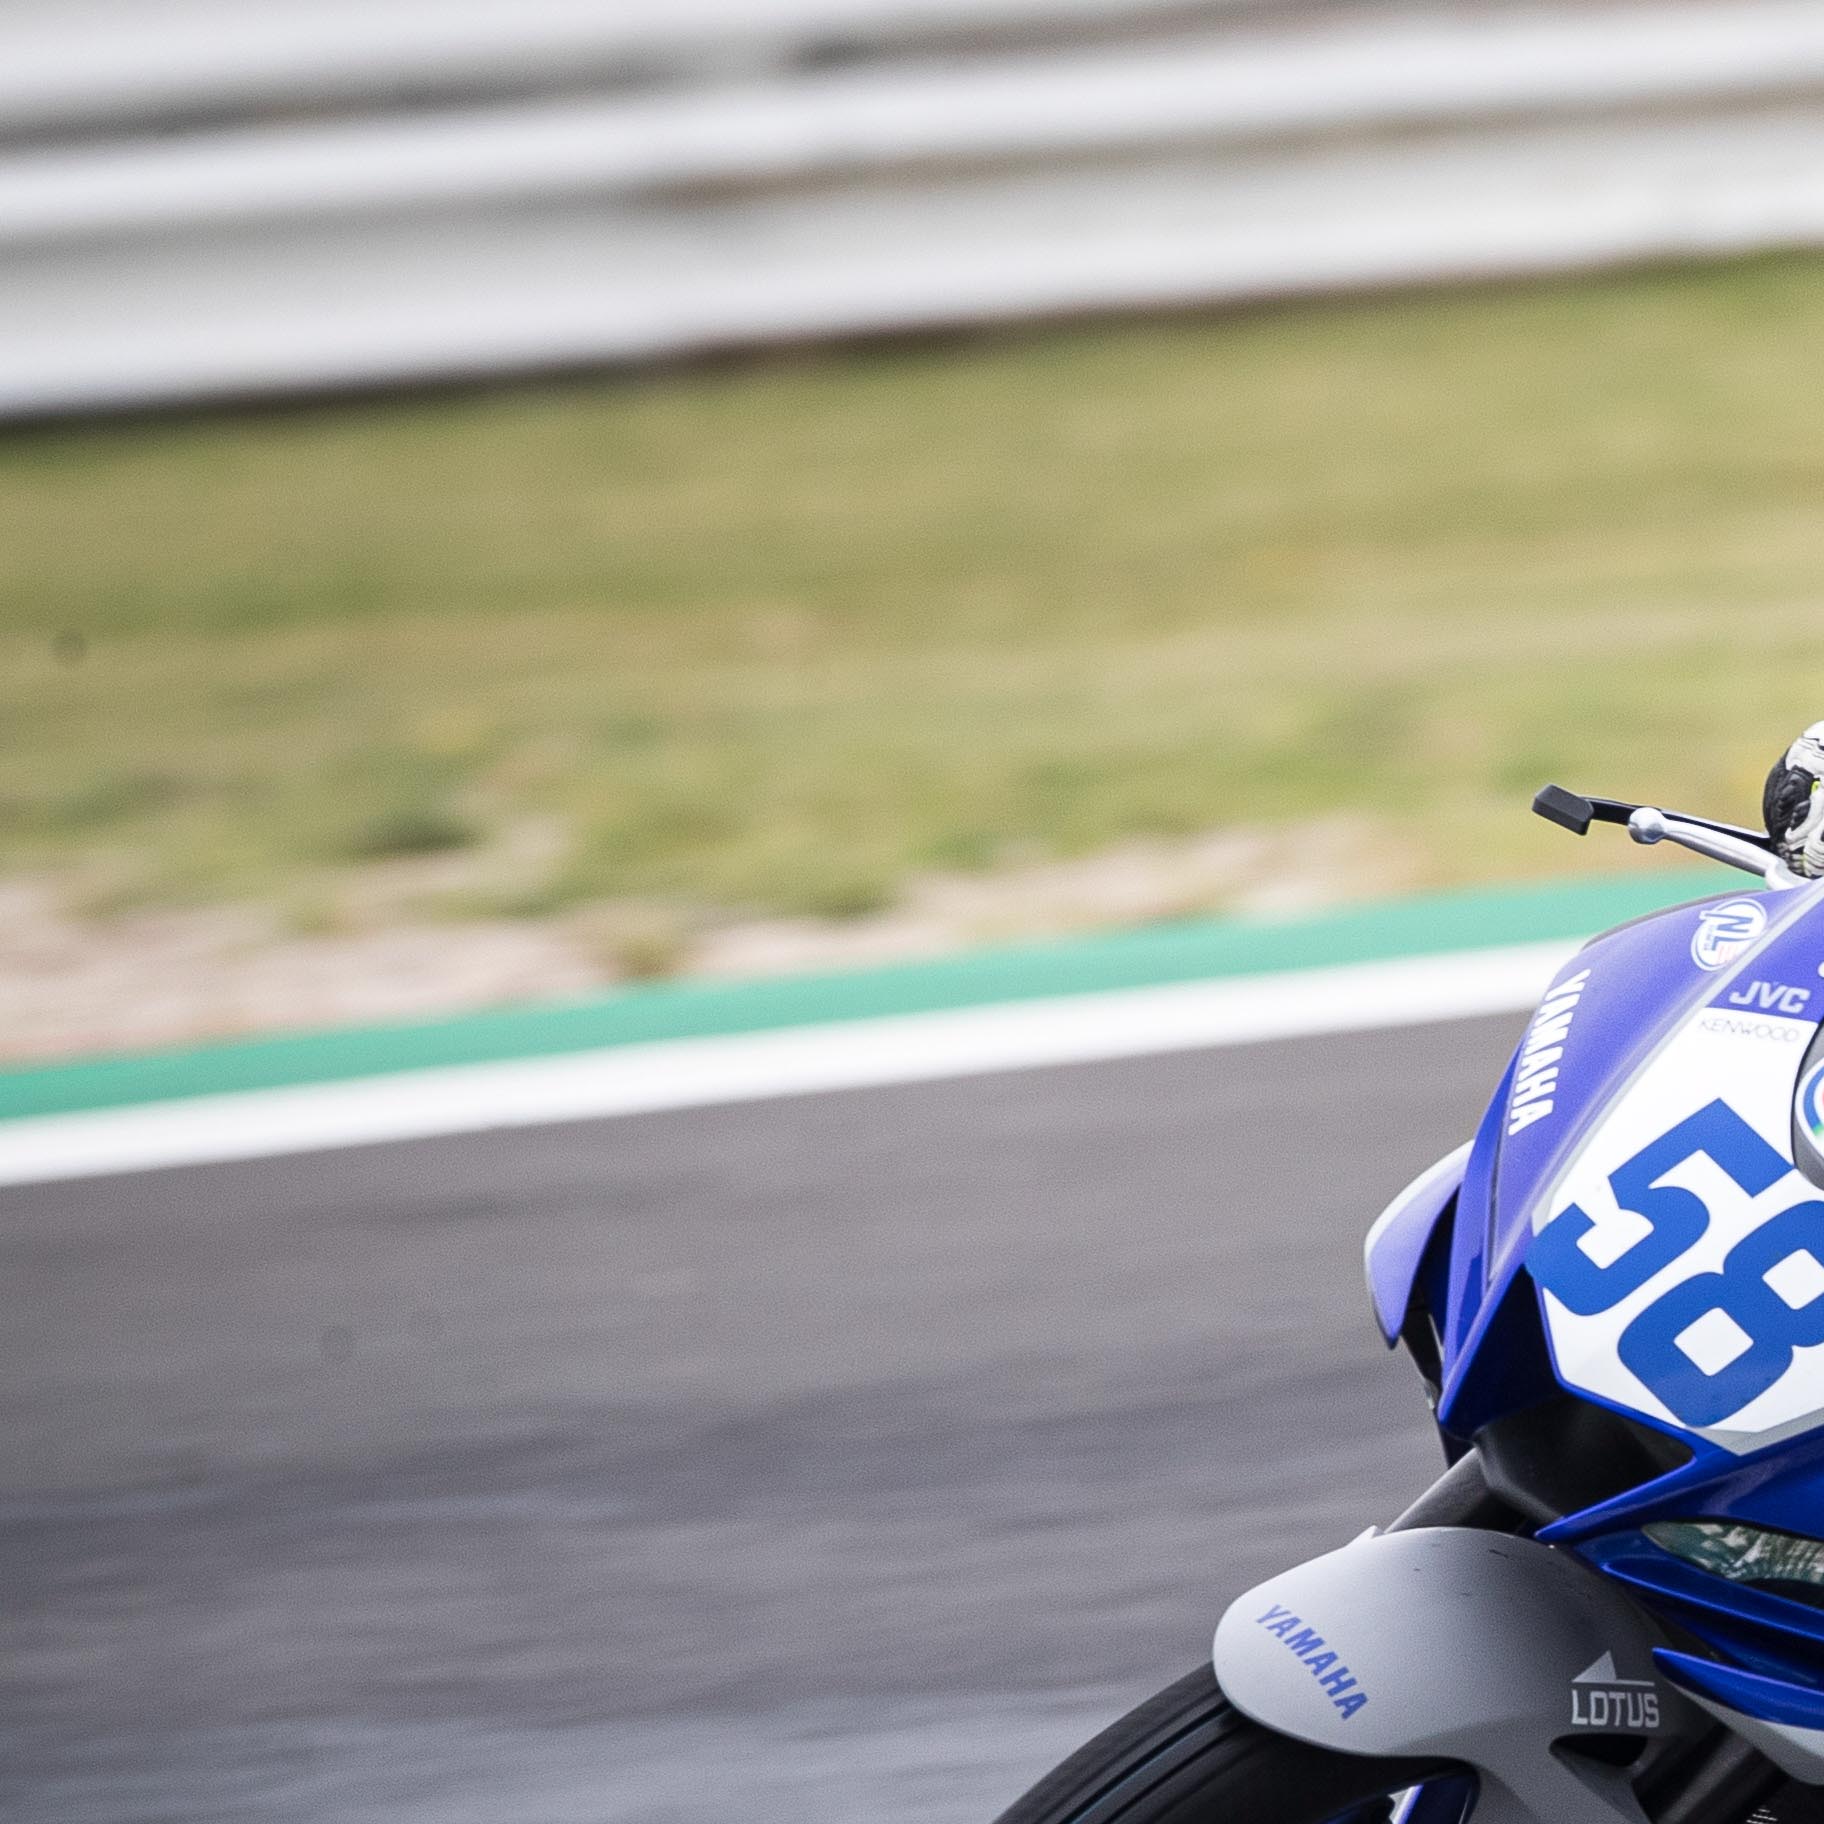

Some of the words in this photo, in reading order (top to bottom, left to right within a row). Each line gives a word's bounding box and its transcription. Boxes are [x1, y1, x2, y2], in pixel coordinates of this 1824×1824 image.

[1729, 980, 1812, 1014] JVC
[1701, 1018, 1800, 1042] KENWOOD
[1508, 969, 1592, 1137] YAMAHA
[1256, 1604, 1369, 1720] YAMAHA
[1571, 1689, 1660, 1728] LOTUS
